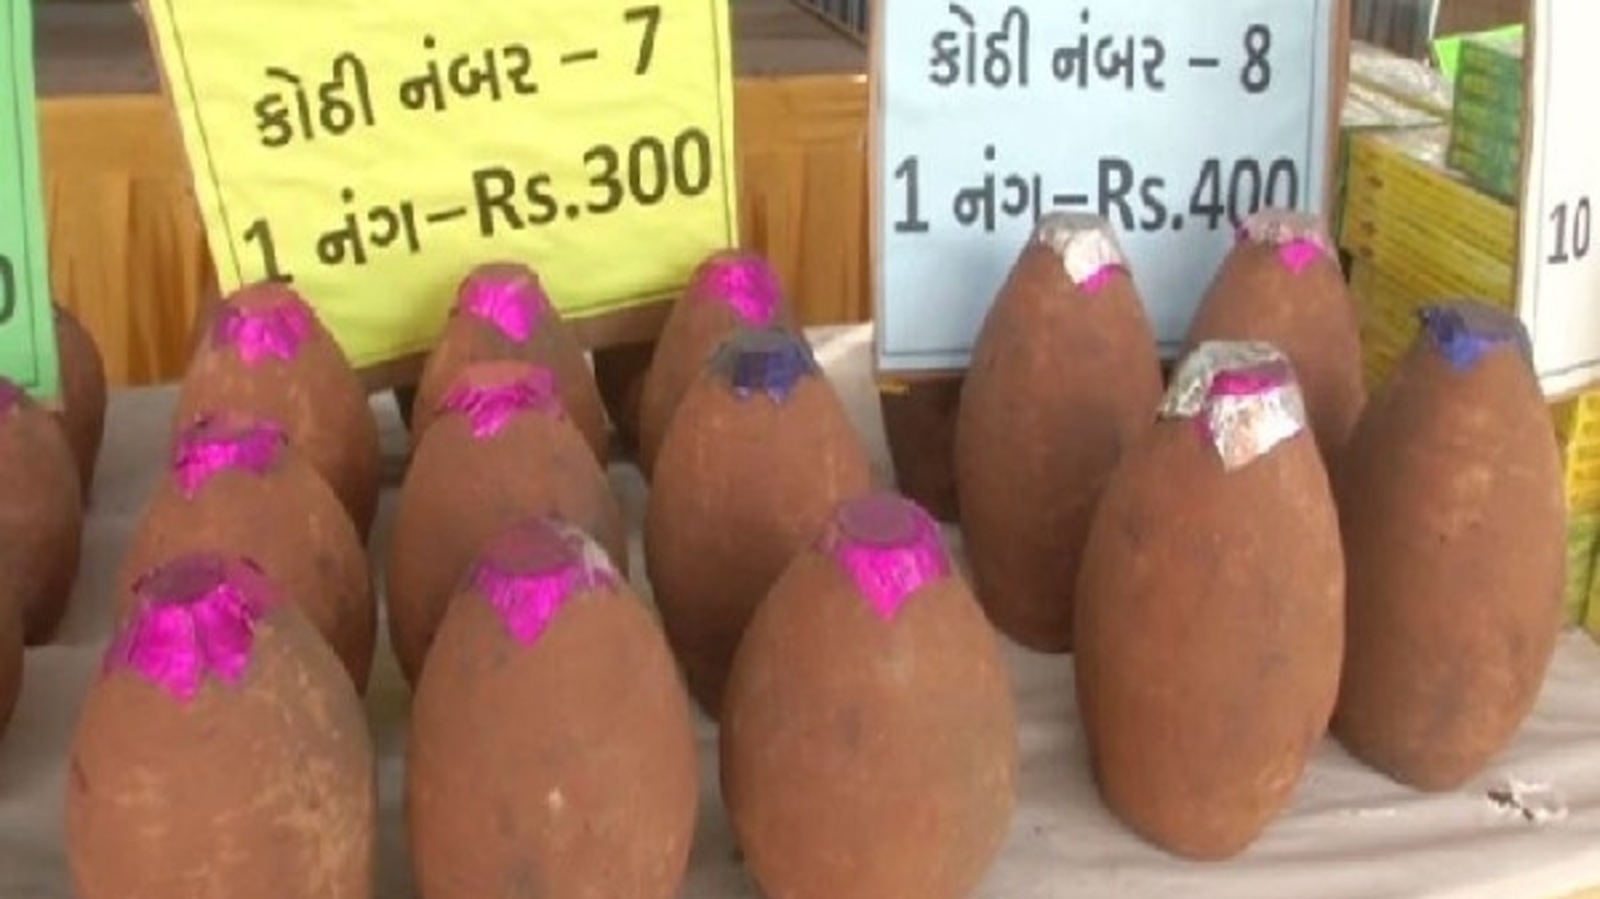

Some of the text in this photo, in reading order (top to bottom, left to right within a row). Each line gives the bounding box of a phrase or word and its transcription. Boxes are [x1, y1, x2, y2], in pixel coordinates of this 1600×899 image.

[253, 52, 375, 148] કોઠી
[399, 35, 539, 111] નંબર
[623, 5, 661, 75] 7
[929, 3, 1030, 87] કોઠી
[1052, 8, 1166, 90] નંબર
[1240, 23, 1272, 94] 8
[894, 155, 930, 232] 1
[1547, 196, 1592, 264] 10
[243, 217, 293, 284] 1
